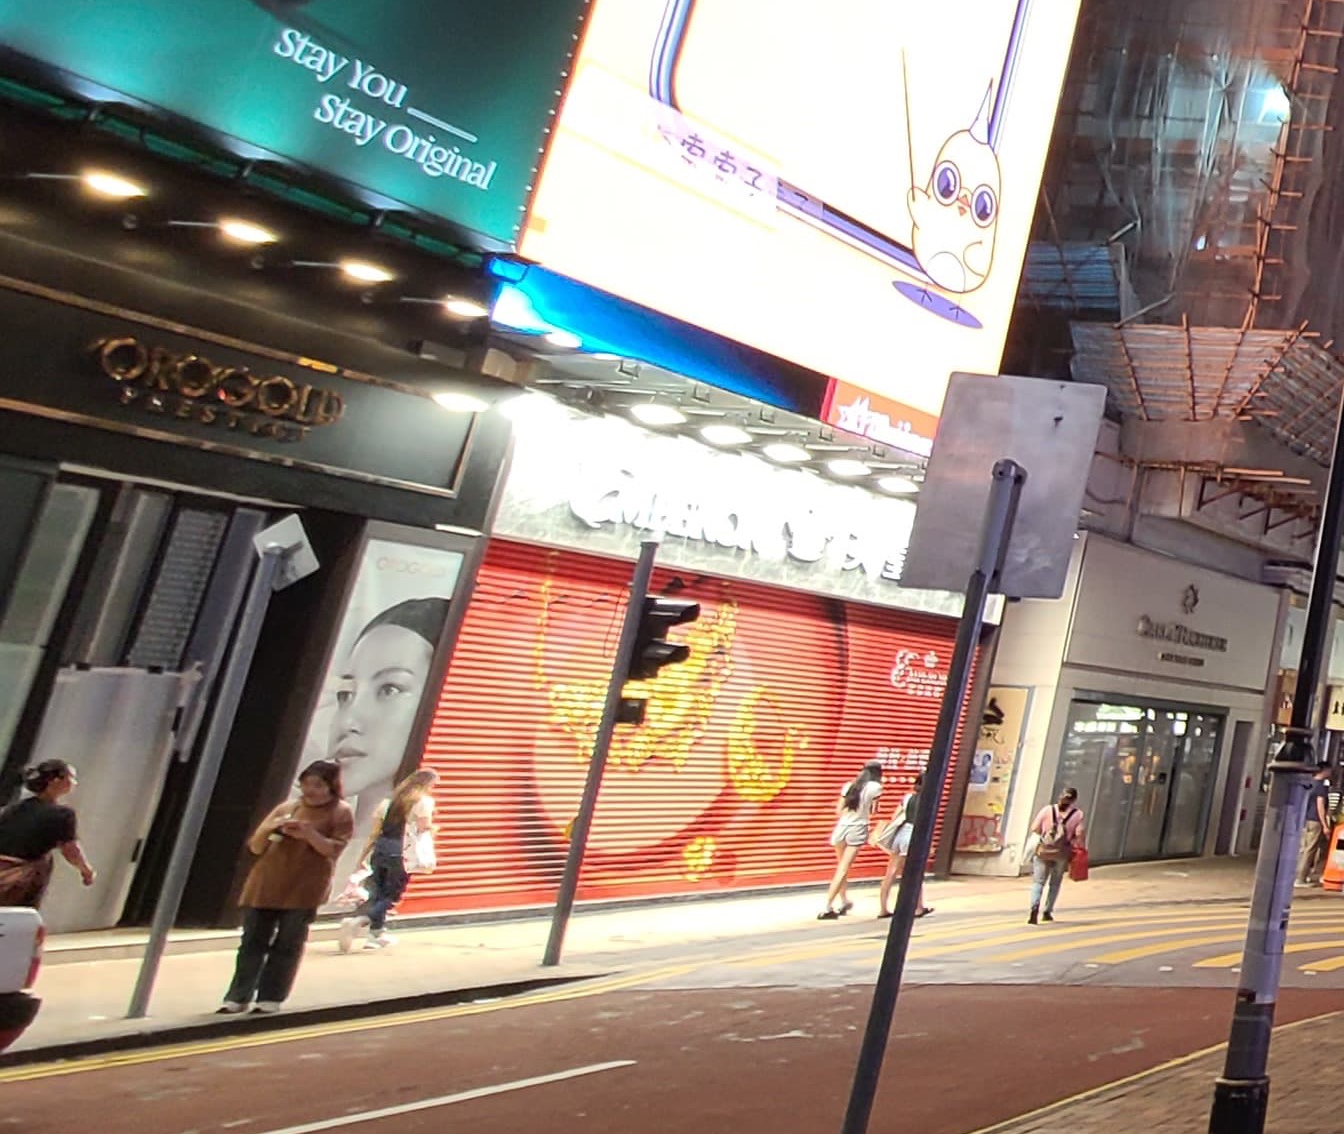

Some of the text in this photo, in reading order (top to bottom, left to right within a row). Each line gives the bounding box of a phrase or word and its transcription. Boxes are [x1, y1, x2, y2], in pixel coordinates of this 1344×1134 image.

[273, 27, 409, 109] Stay You
[313, 93, 498, 191] Stay Original
